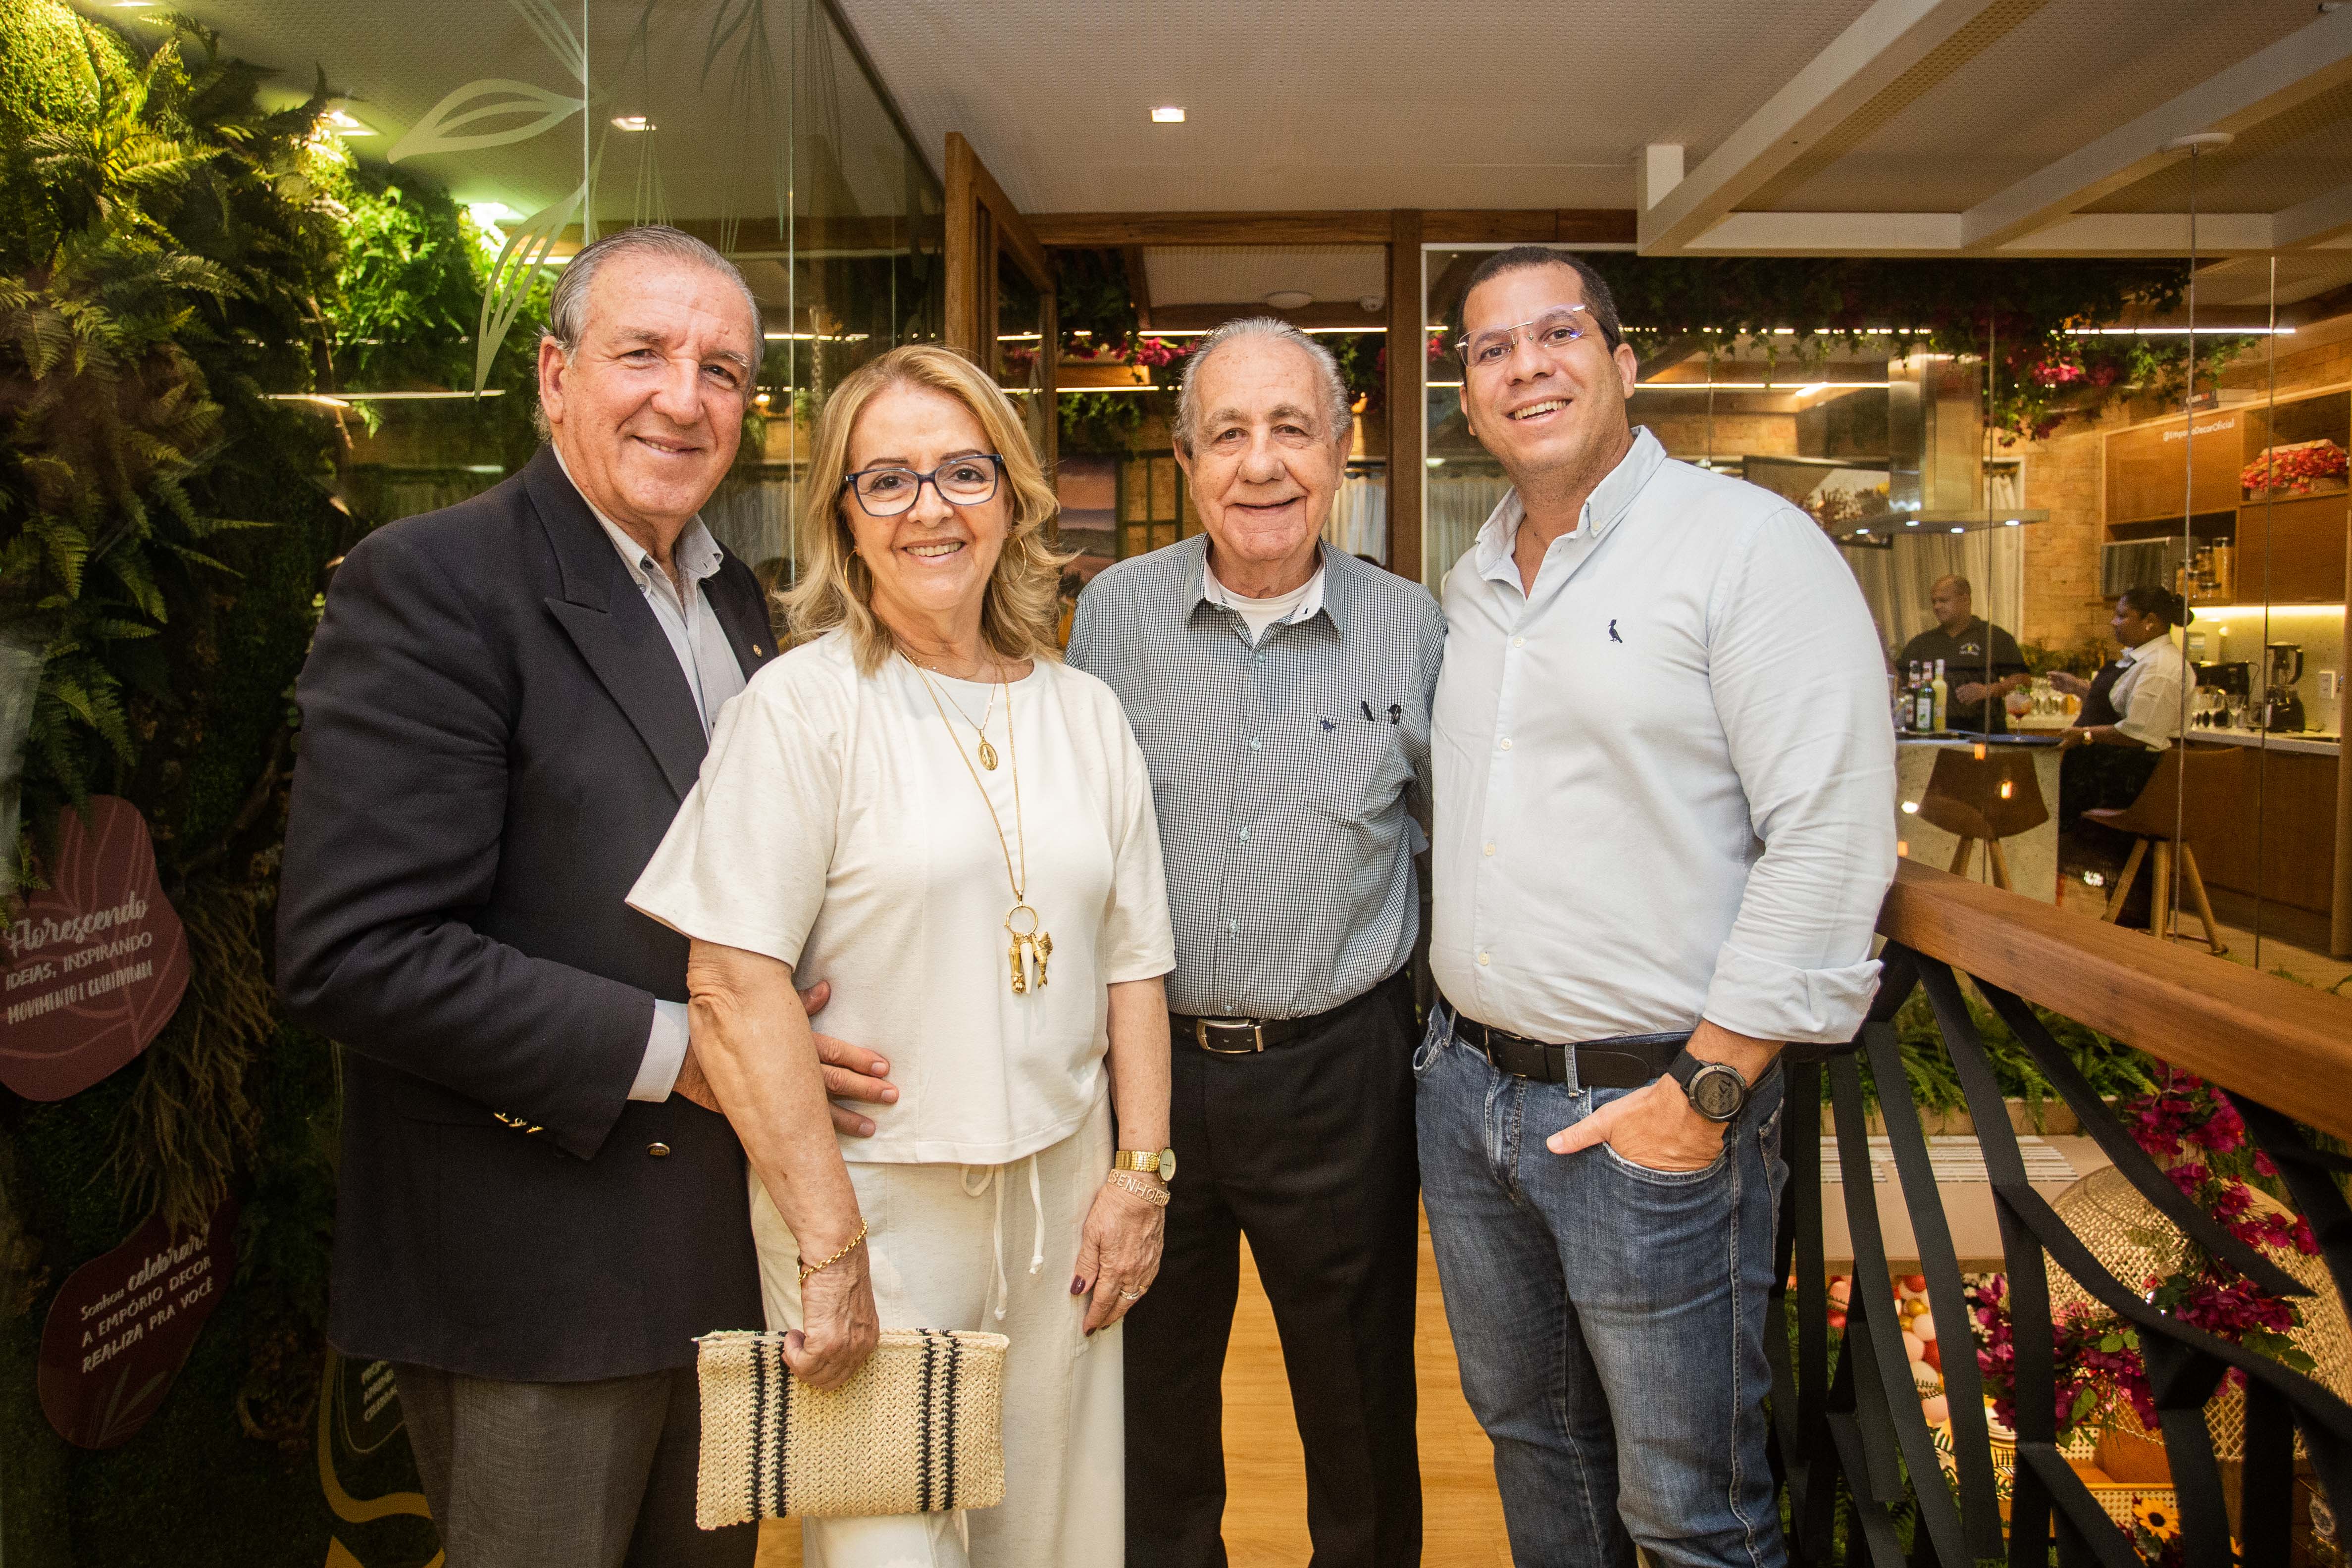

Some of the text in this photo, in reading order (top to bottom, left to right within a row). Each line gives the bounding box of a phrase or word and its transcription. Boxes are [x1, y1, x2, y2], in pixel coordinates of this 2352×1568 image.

[2, 890, 149, 958] Florescendo
[6, 931, 153, 991] IDEIAS, INSPIRANDO
[7, 984, 77, 1025] MOVIMENTO
[78, 982, 85, 1001] E
[80, 1288, 124, 1321] Sonhou
[81, 1255, 212, 1348] A EMPÓRIO DECOR
[82, 1276, 214, 1373] REALIZA PRA VOCÊ
